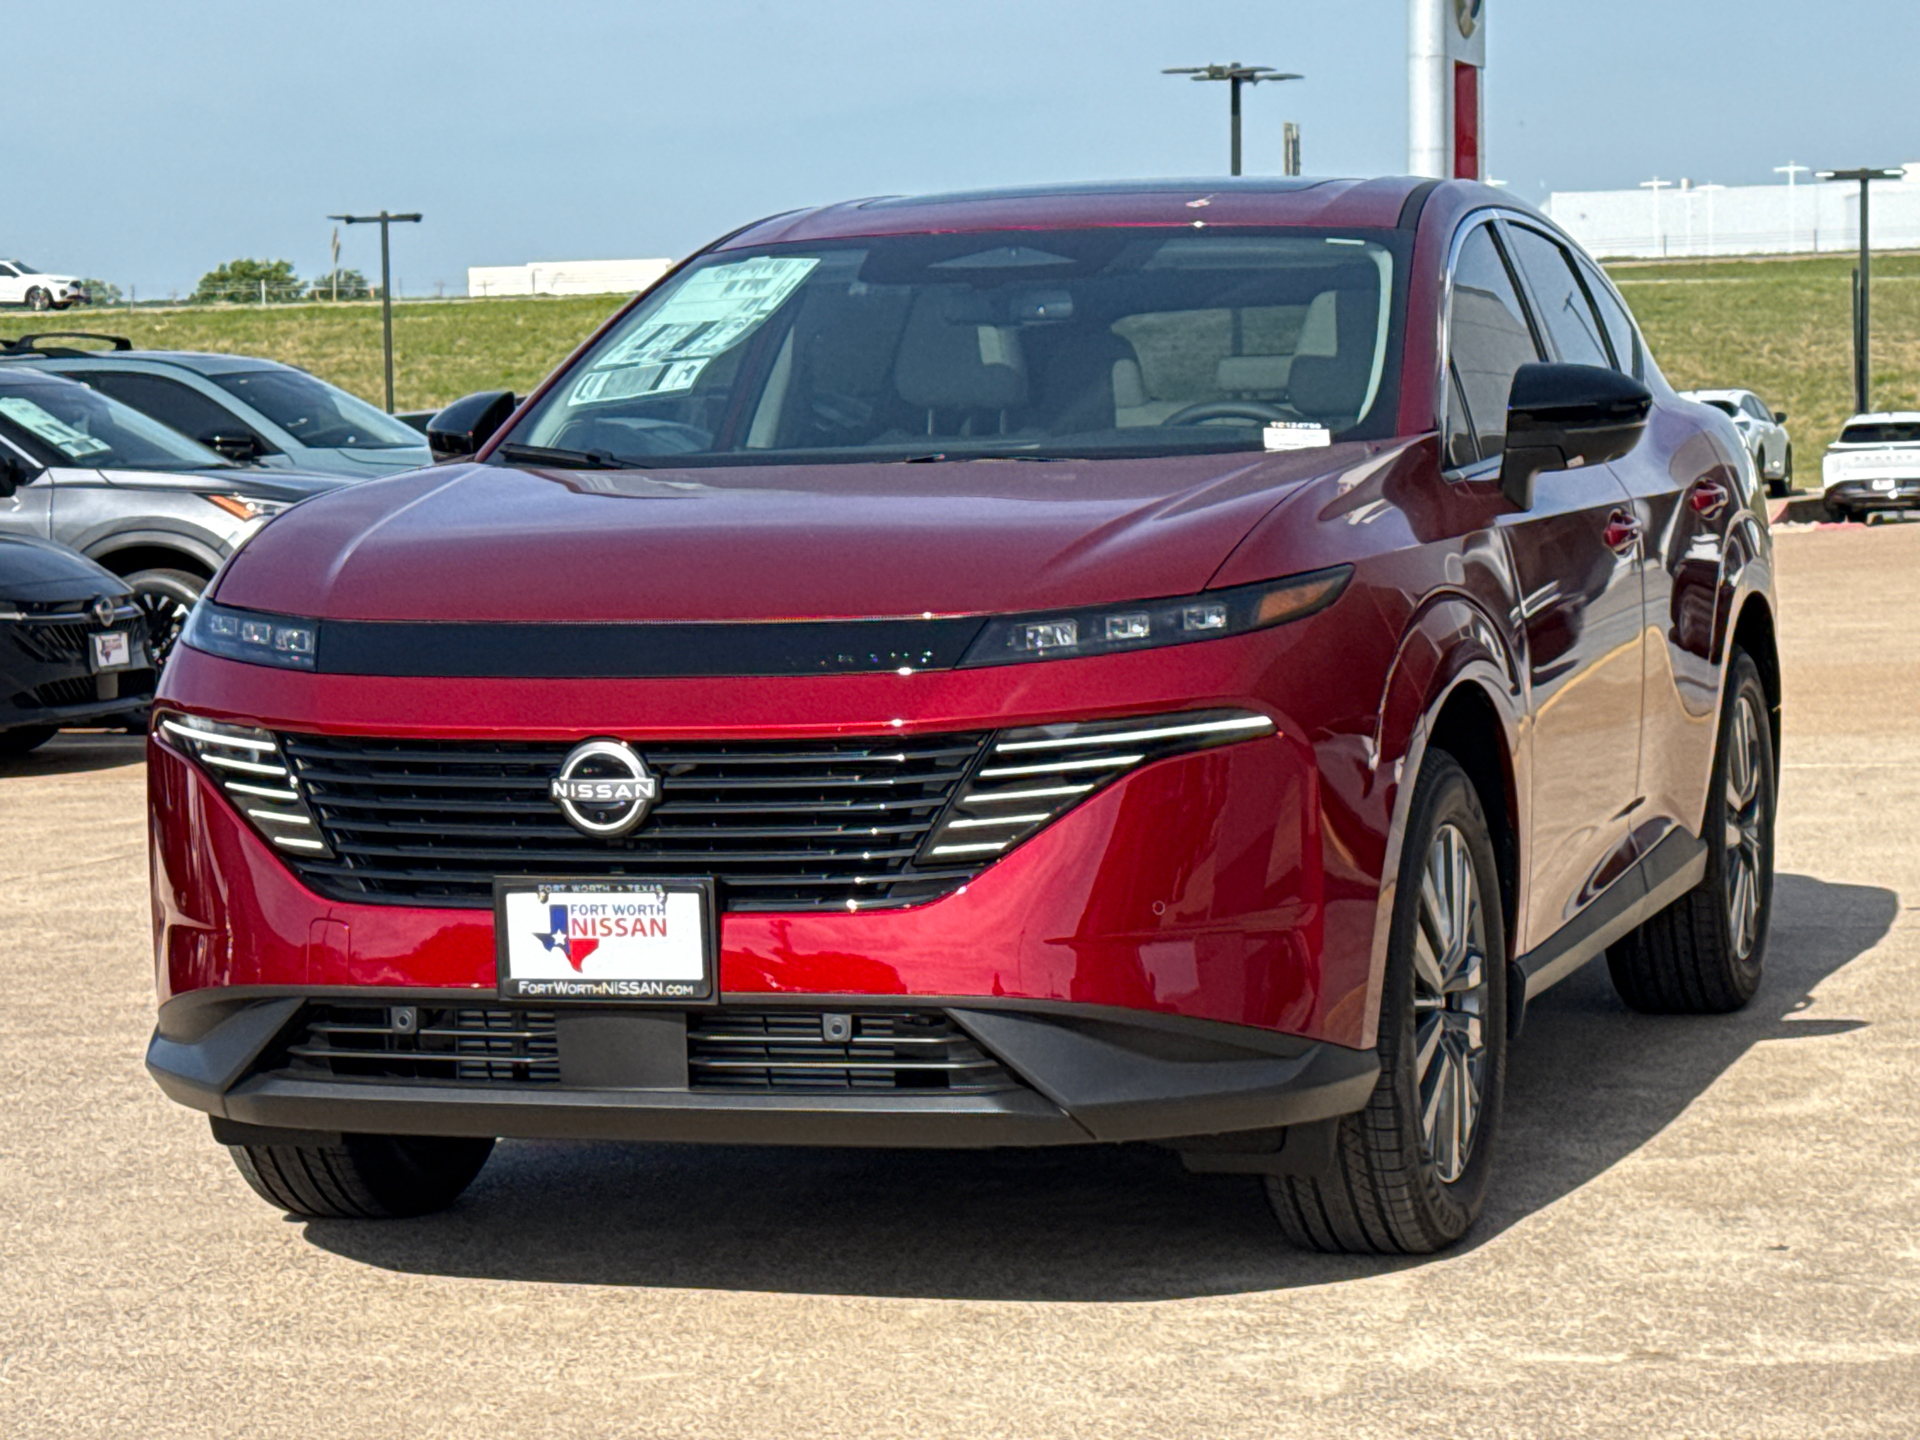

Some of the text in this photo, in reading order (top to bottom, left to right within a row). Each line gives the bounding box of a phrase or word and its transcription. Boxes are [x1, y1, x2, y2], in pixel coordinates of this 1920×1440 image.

[553, 781, 654, 798] NISSAN
[538, 884, 663, 892] FORT WORTH TEXAS
[570, 904, 666, 916] FORT WORTH
[571, 917, 667, 937] NISSAN
